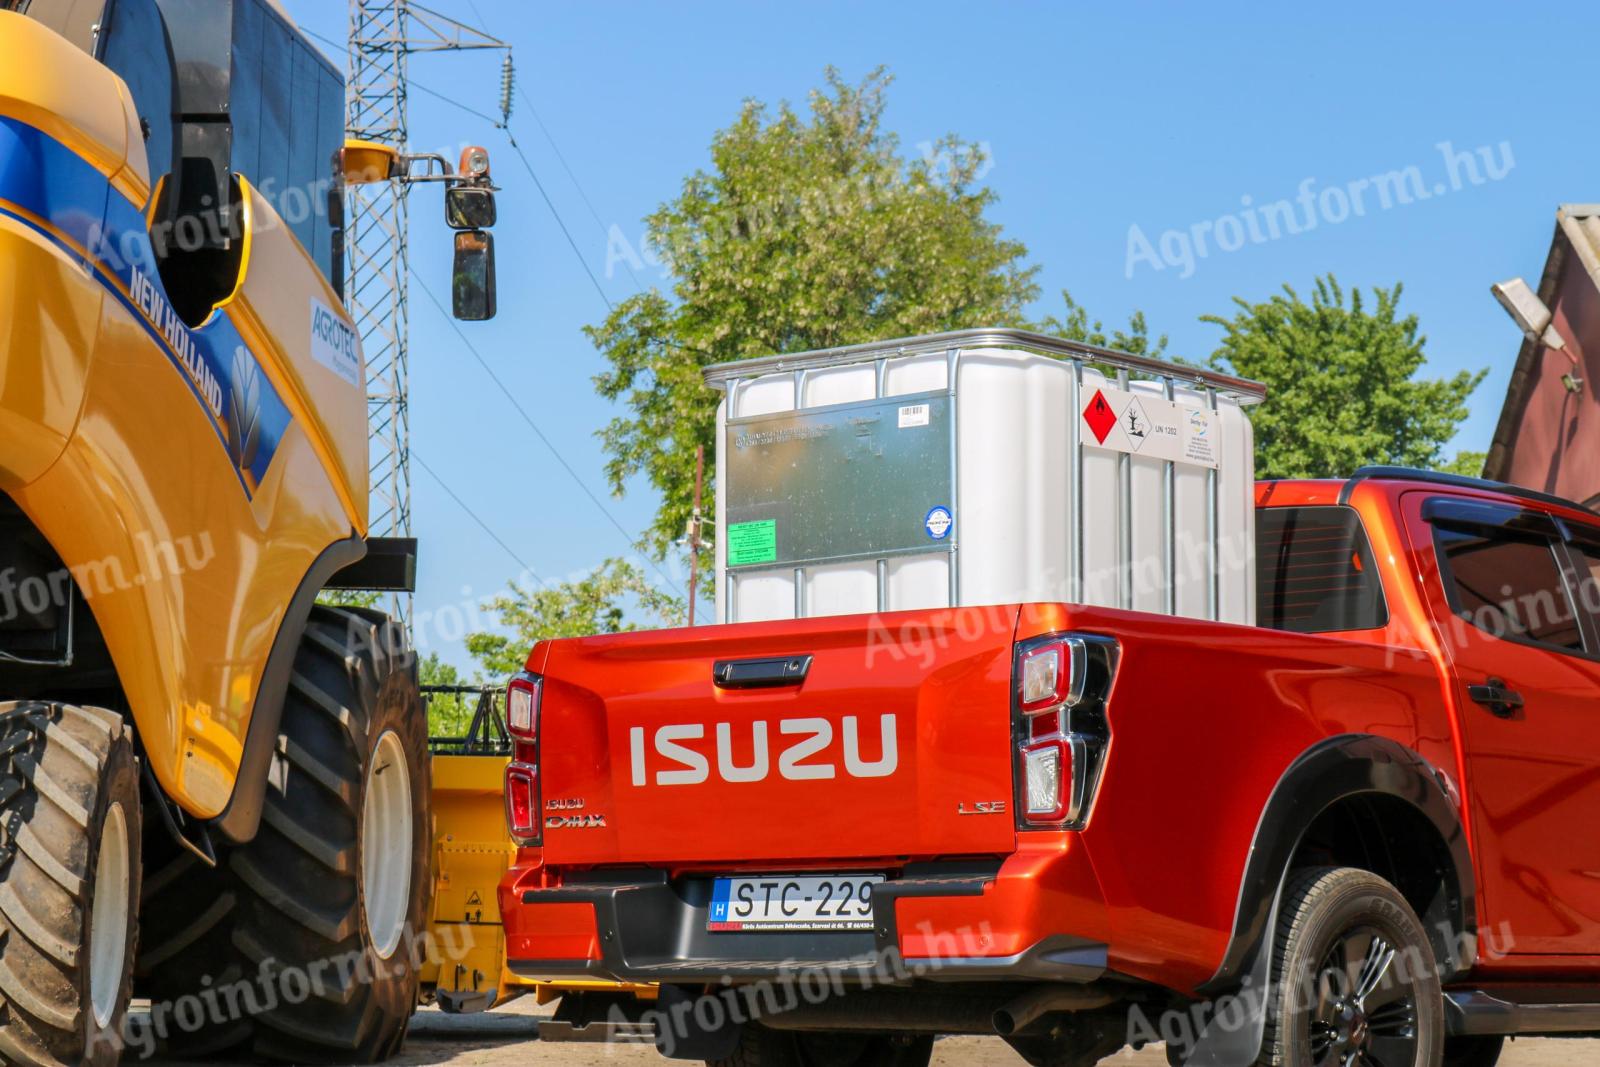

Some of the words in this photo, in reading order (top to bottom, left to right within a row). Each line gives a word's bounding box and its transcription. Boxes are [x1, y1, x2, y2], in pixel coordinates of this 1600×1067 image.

[129, 264, 164, 329] NEW
[164, 305, 223, 417] HOLLAND
[312, 305, 358, 363] AGROTEC
[1155, 425, 1164, 433] UN
[630, 713, 898, 786] ISUZU
[545, 798, 585, 810] ISUZU
[958, 801, 1006, 814] LSE
[715, 904, 725, 916] H
[735, 881, 874, 917] STC-229
